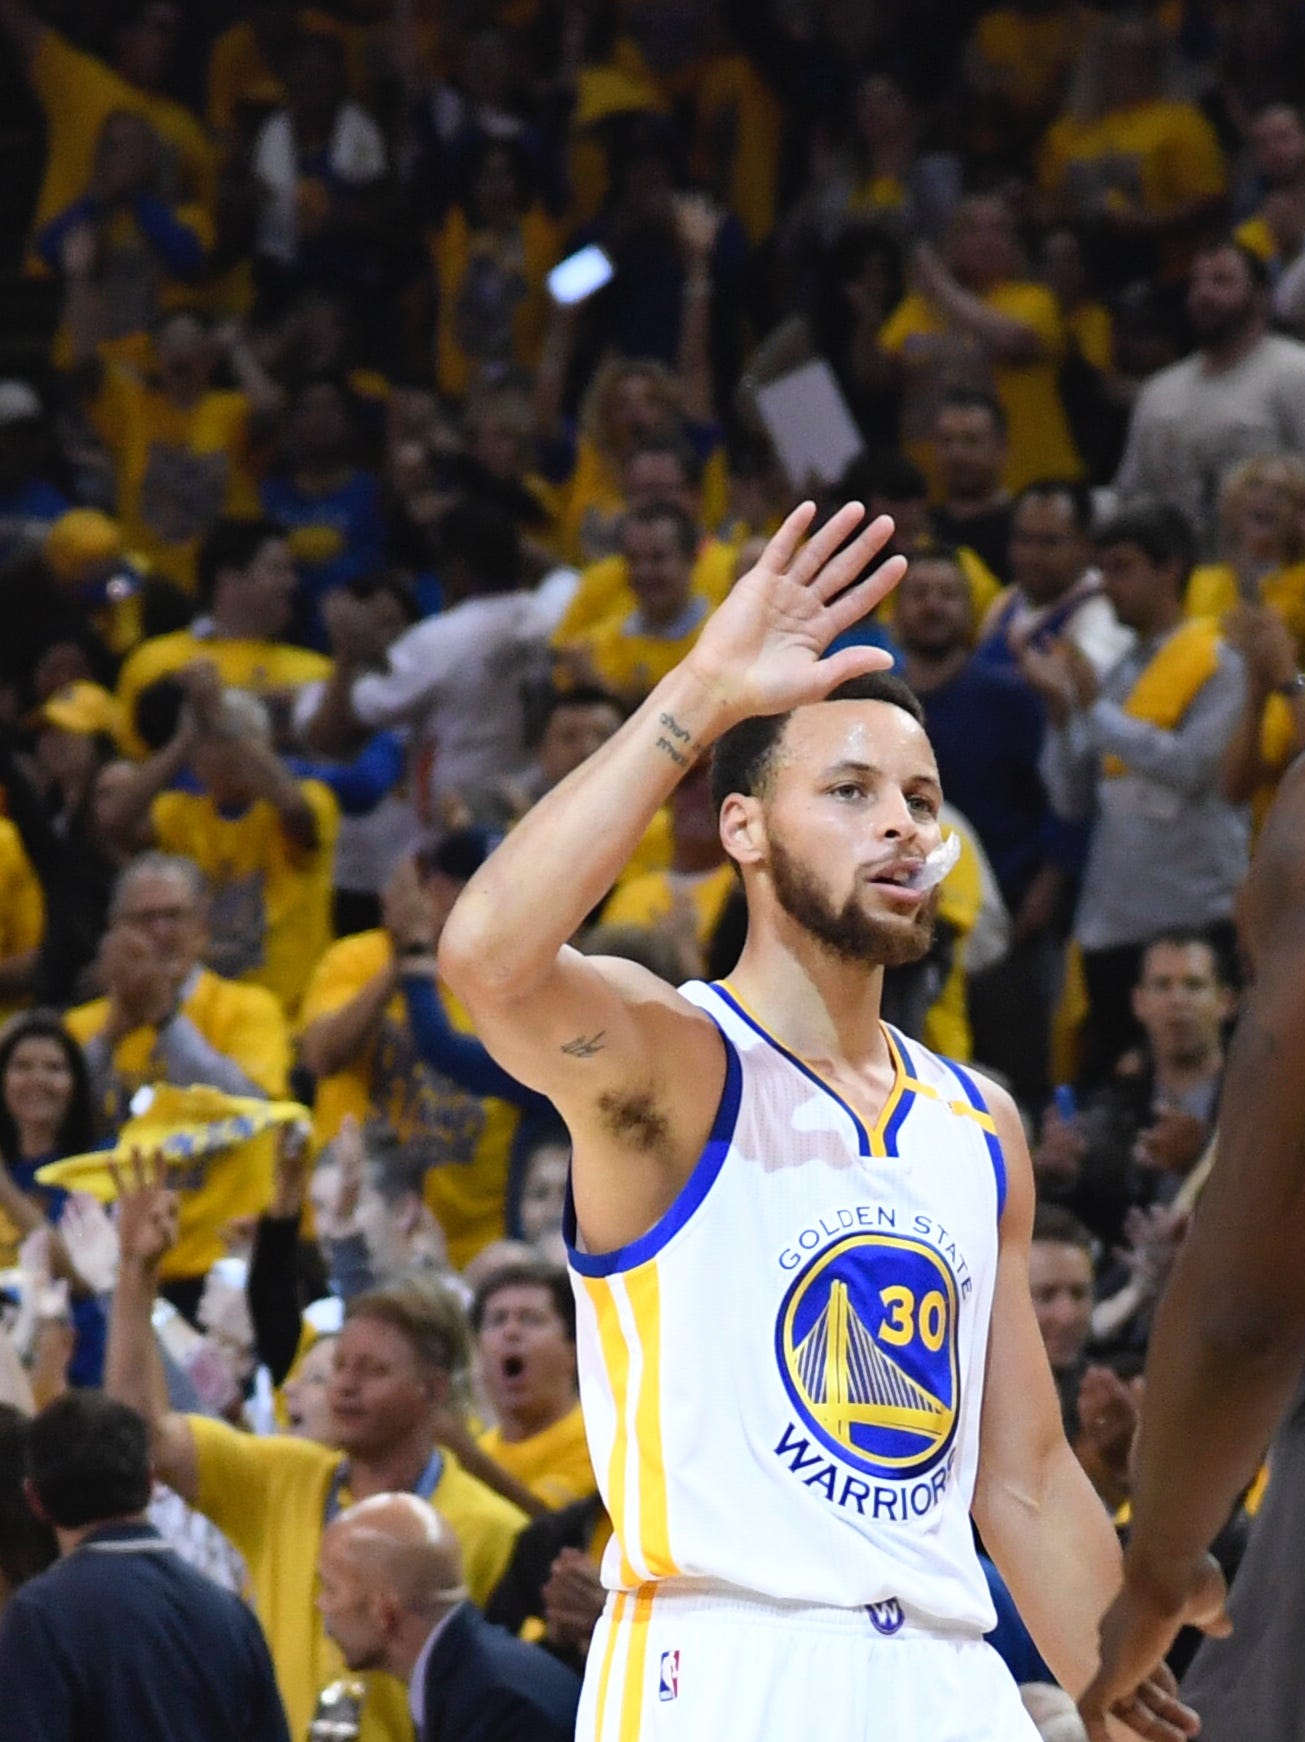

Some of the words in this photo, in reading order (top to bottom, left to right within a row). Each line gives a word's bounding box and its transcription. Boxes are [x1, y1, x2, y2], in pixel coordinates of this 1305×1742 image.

[778, 1205, 896, 1271] GOLDEN
[912, 1214, 974, 1300] STATE
[878, 1284, 946, 1352] 30
[872, 1600, 899, 1625] W
